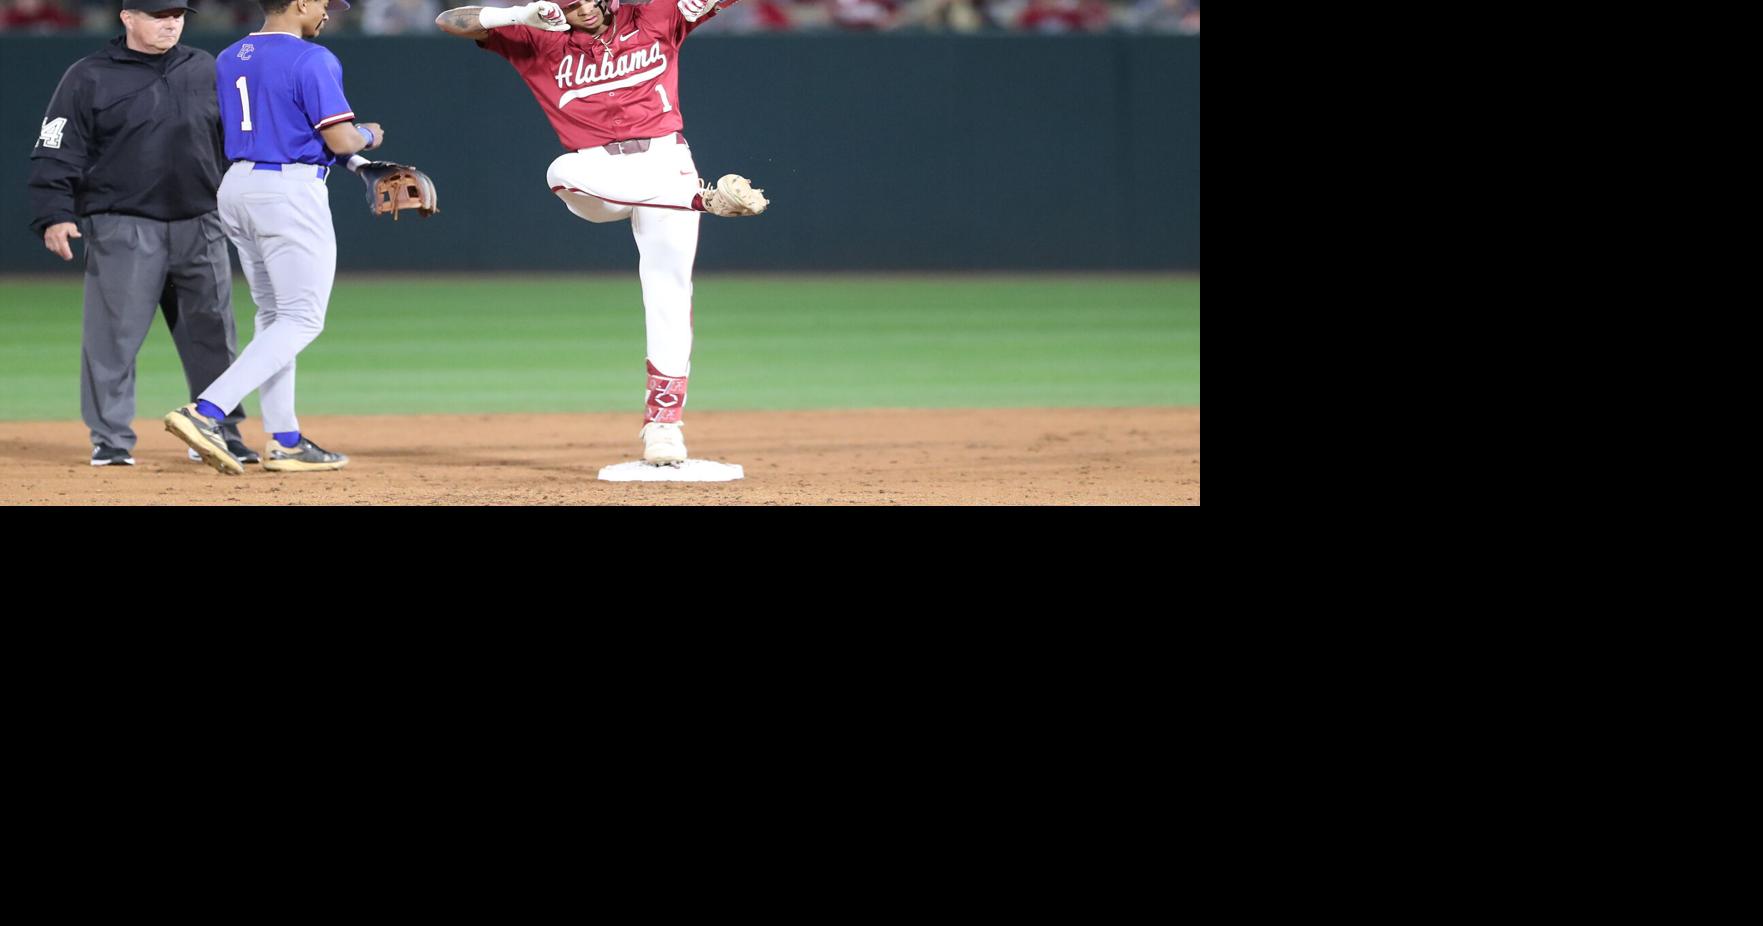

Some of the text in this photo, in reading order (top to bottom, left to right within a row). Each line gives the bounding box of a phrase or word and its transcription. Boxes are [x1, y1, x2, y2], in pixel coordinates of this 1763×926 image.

[555, 41, 665, 89] Alabama
[236, 76, 252, 131] 1
[655, 84, 672, 113] 1
[35, 116, 67, 149] 4
